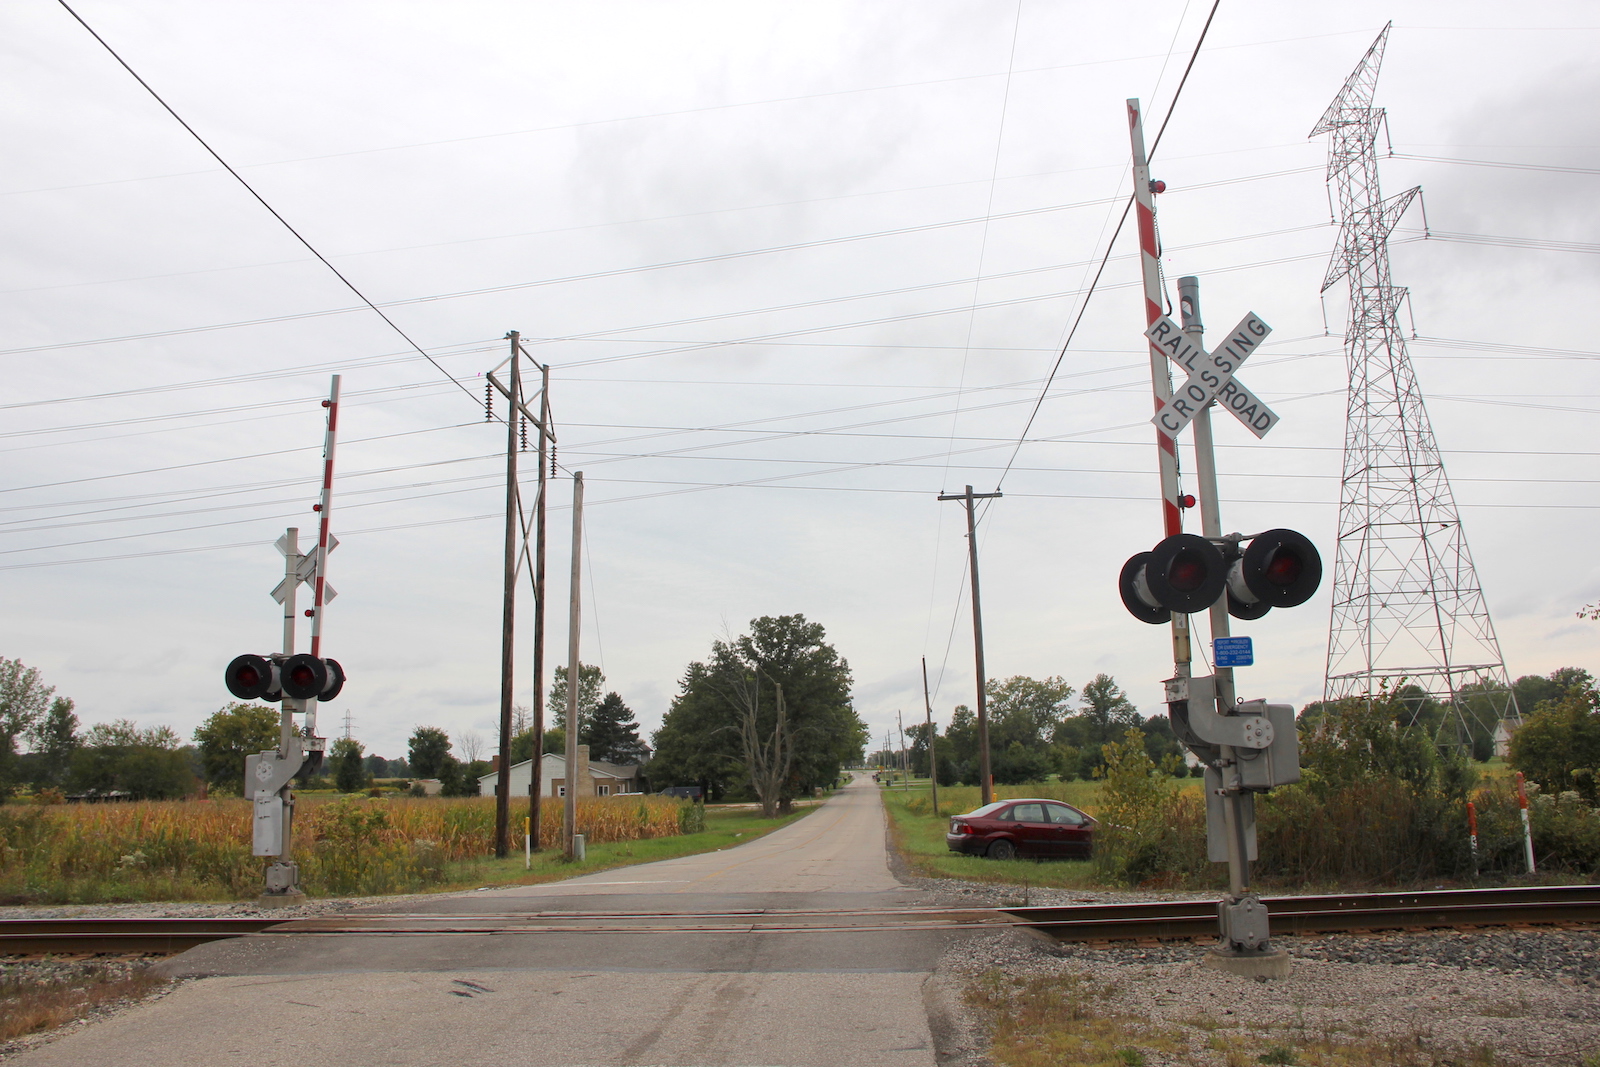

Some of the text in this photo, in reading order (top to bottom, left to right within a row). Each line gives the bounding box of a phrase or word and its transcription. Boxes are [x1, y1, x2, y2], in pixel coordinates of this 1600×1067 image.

[1151, 321, 1271, 431] RAIL ROAD
[1160, 319, 1266, 432] CROSSING
